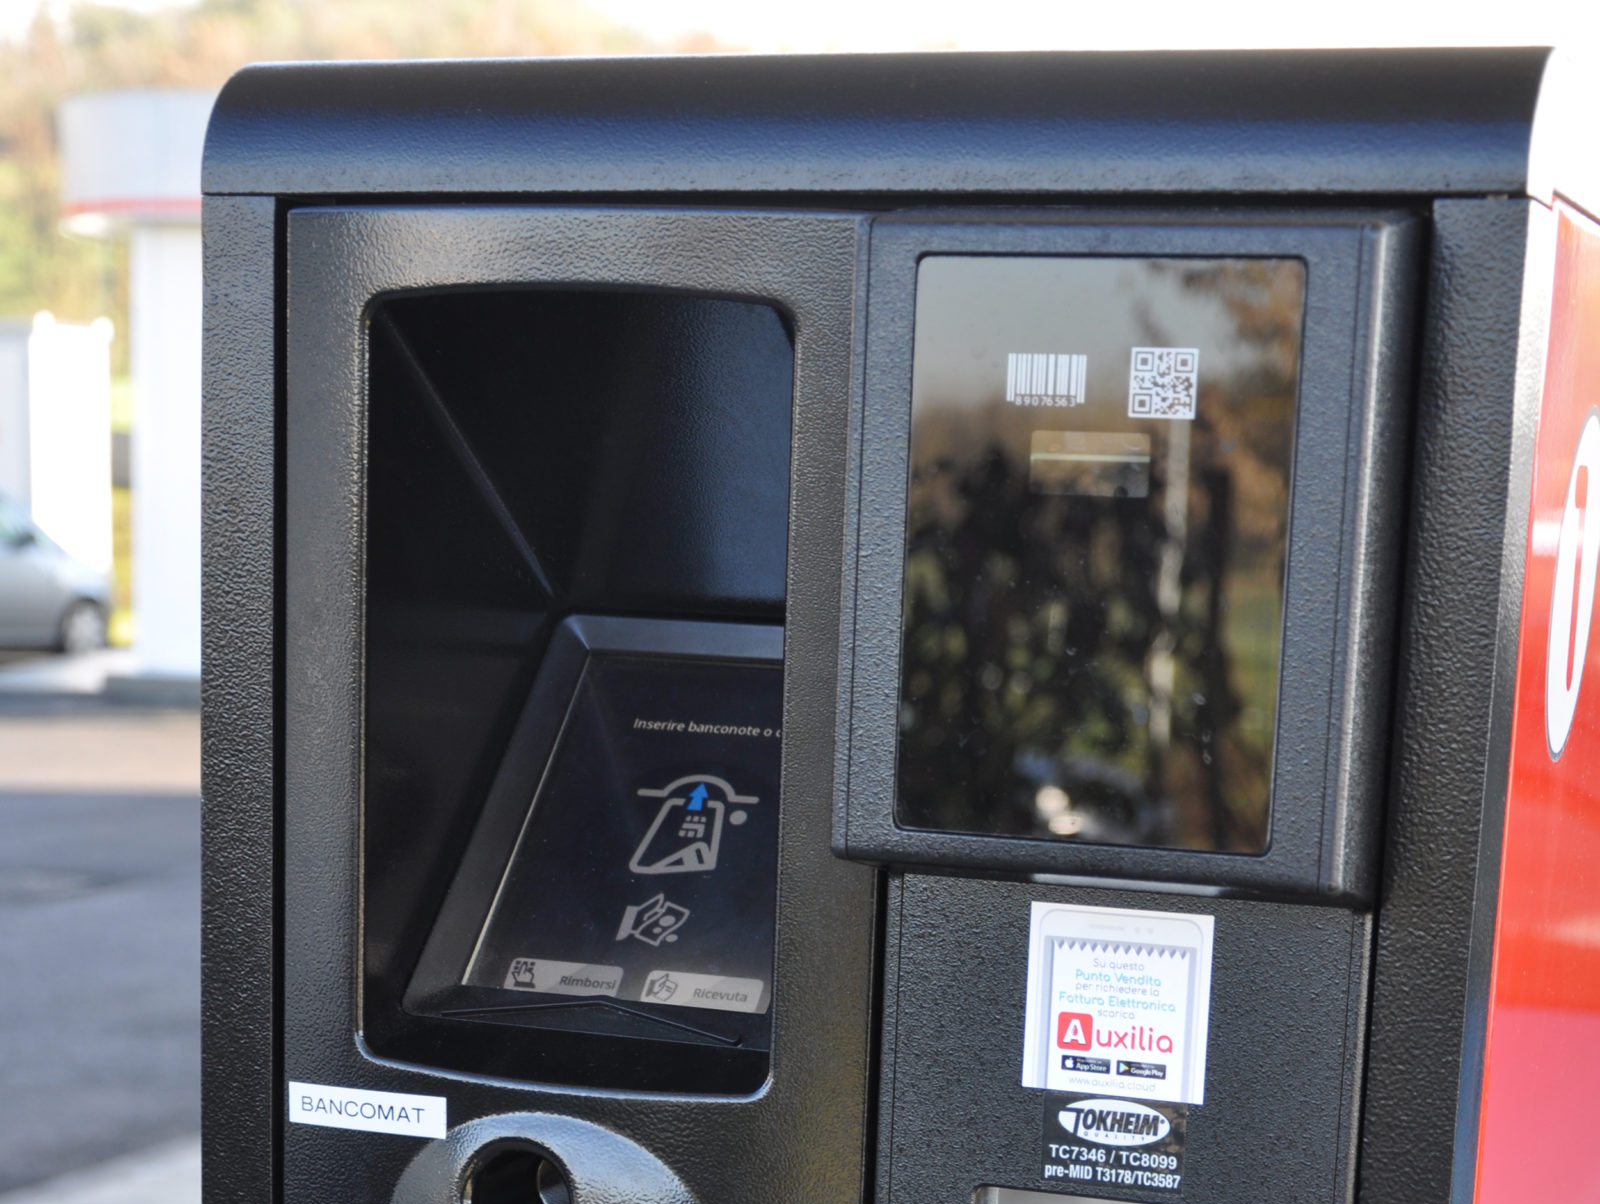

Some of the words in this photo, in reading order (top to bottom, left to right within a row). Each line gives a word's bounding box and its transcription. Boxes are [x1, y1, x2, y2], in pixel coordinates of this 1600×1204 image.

[1015, 395, 1076, 407] 89076563
[633, 718, 686, 732] Inserire
[688, 721, 761, 737] banconote
[763, 727, 773, 737] o
[1093, 958, 1106, 969] Su
[1109, 959, 1145, 972] questo
[559, 975, 617, 991] Rimborsi
[1075, 968, 1111, 983] Punto
[1114, 972, 1162, 987] Vendita
[692, 987, 749, 1003] Ricevuta
[1075, 982, 1093, 992] per
[1095, 981, 1148, 996] richiedere
[1150, 987, 1160, 997] la
[1058, 991, 1105, 1006] Fattura
[1108, 995, 1176, 1013] Elettronica
[1097, 1009, 1136, 1020] scarica
[1060, 1017, 1173, 1054] Auxilia
[1076, 1063, 1089, 1071] App
[1089, 1064, 1107, 1072] Store
[301, 1096, 425, 1124] BANCOMAT
[1060, 1107, 1160, 1137] TOKHEIM
[1049, 1144, 1107, 1163] TC7346
[1119, 1151, 1178, 1170] TC8099
[1044, 1164, 1093, 1180] pre-MID
[1095, 1167, 1181, 1189] T3178/TC3587
